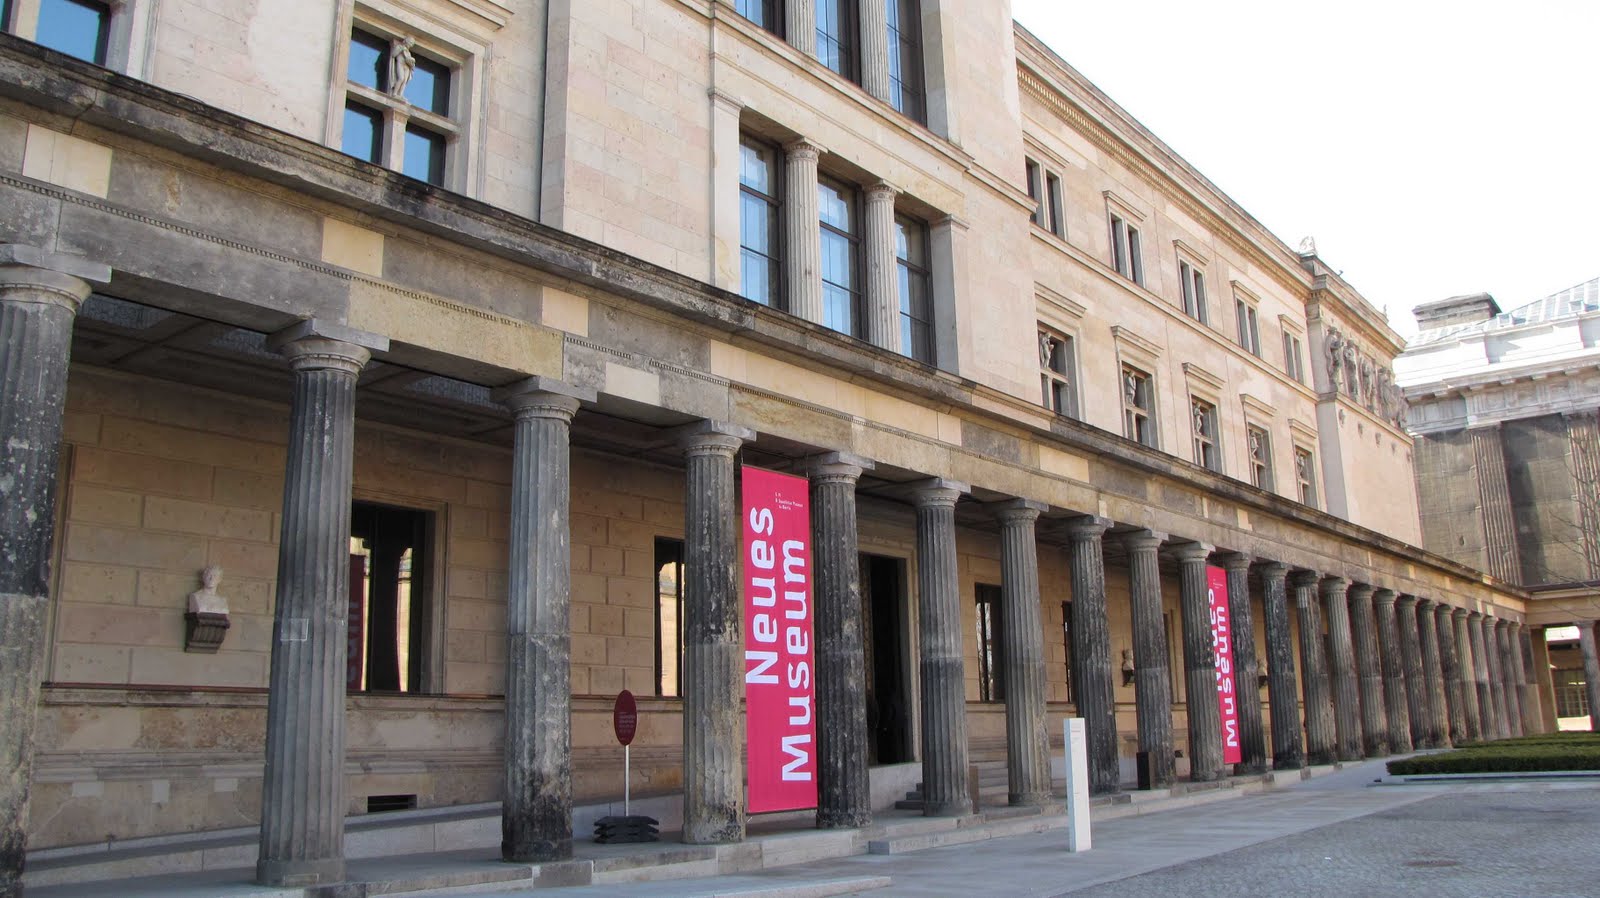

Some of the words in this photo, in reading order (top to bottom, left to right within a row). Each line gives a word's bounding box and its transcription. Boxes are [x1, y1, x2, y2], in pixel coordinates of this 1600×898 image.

[745, 506, 779, 684] Neues
[782, 539, 812, 781] Museum
[1216, 606, 1238, 747] Museum
